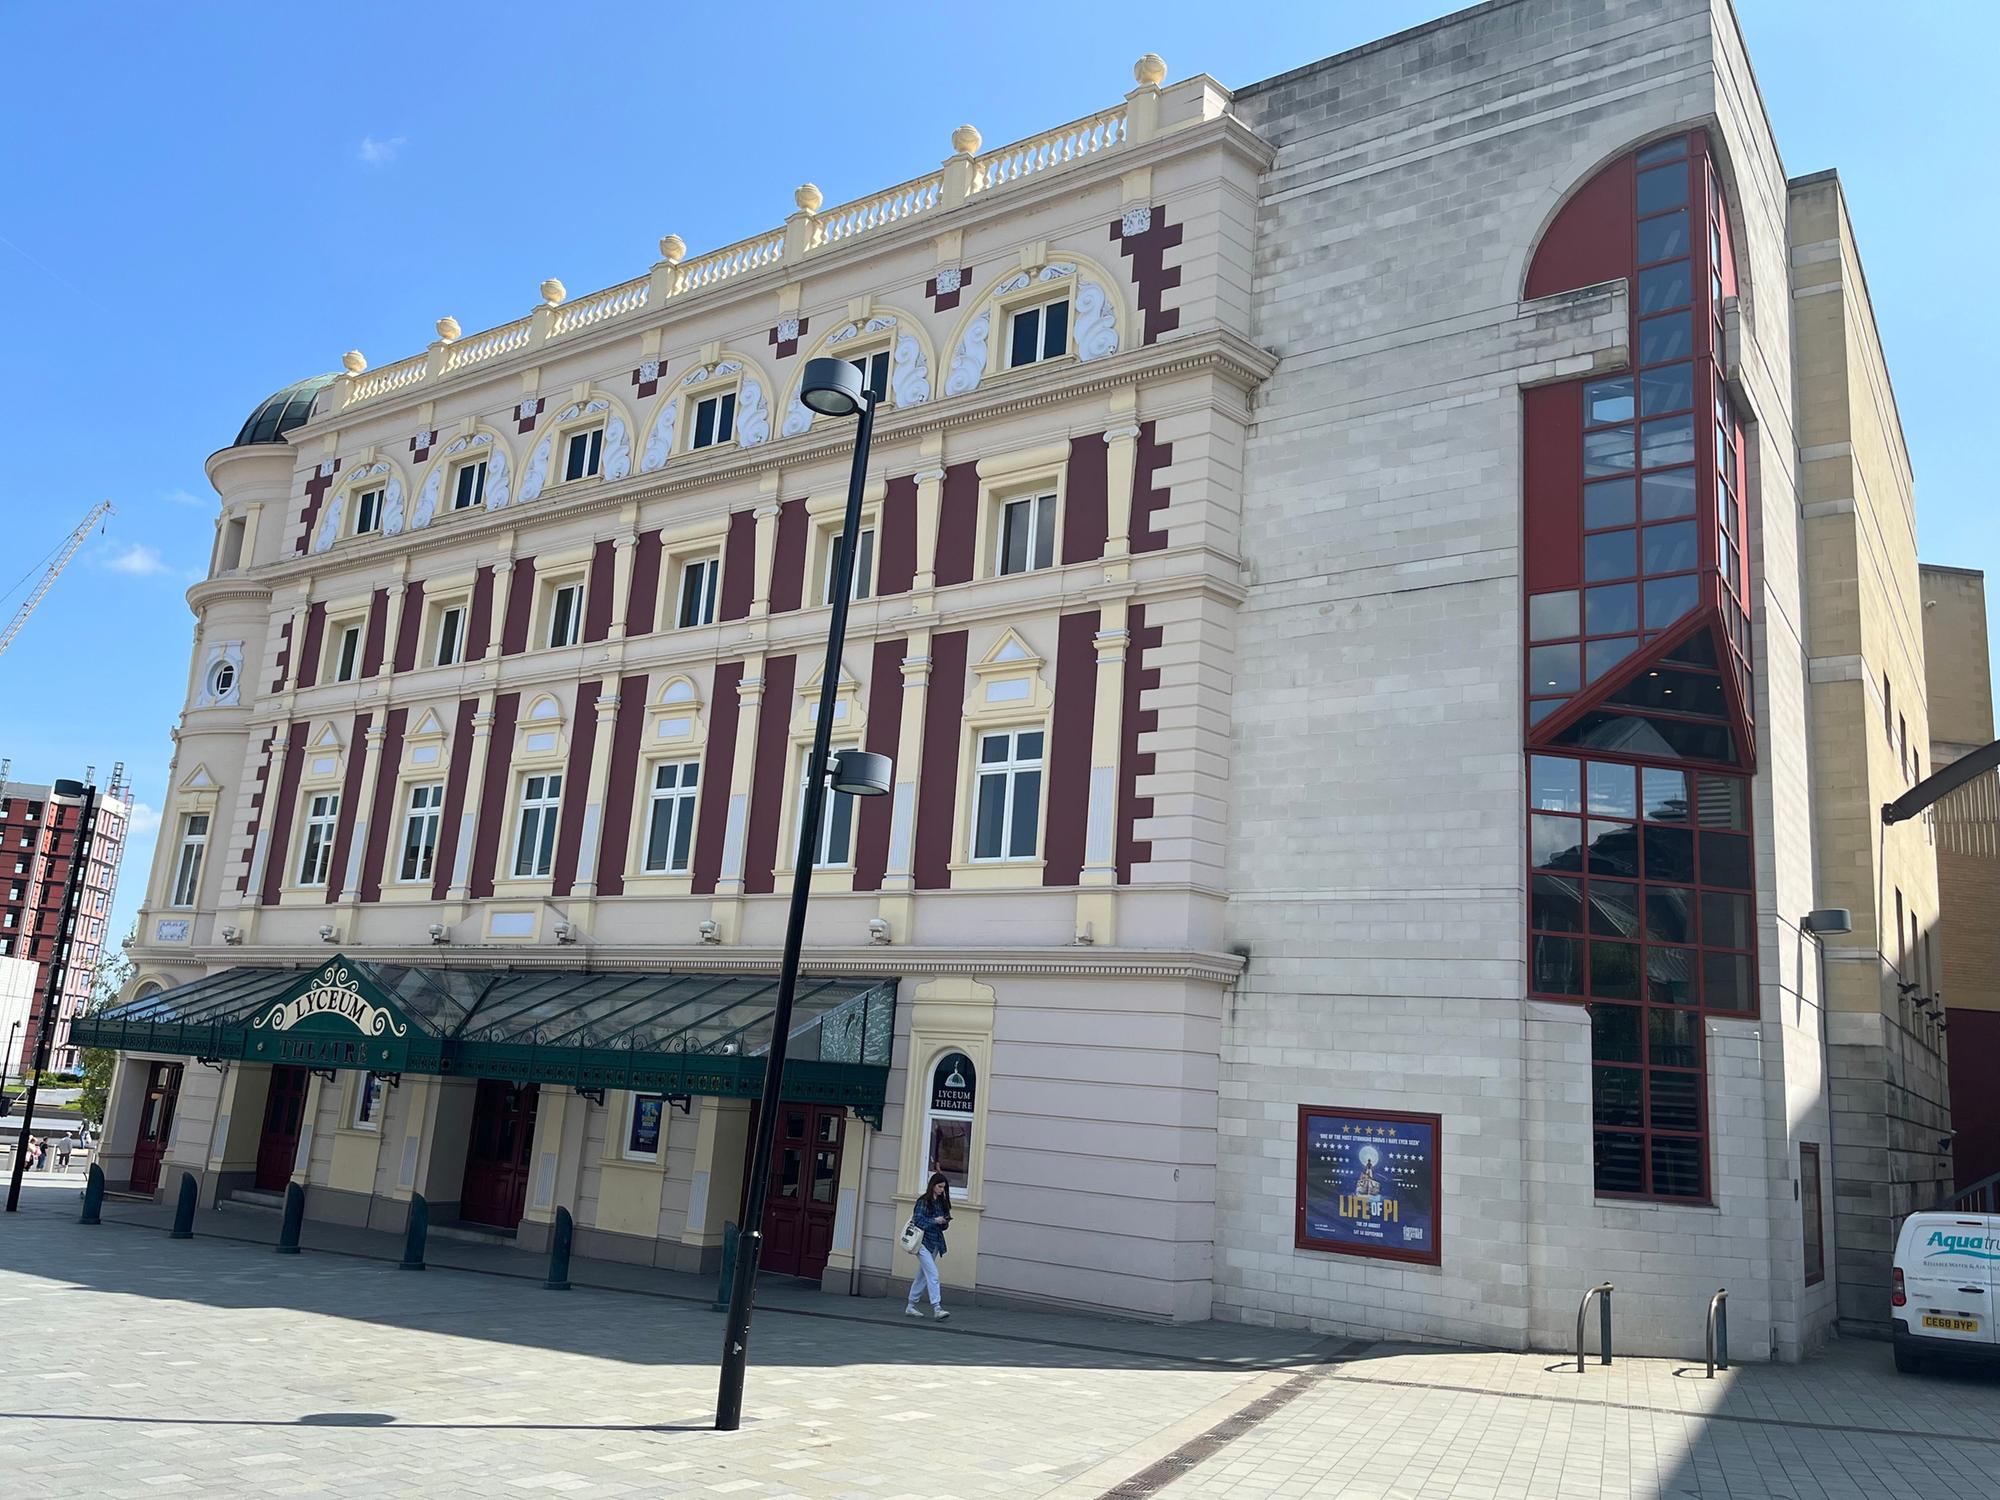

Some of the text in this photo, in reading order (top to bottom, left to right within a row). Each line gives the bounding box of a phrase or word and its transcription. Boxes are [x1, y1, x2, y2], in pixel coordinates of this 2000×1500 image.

[295, 990, 368, 1024] LYCEUM
[279, 1039, 369, 1064] THEATRE
[934, 1099, 973, 1110] THEATRE
[938, 1089, 971, 1100] LYCEUM
[1339, 1195, 1399, 1222] LIFE OF PI
